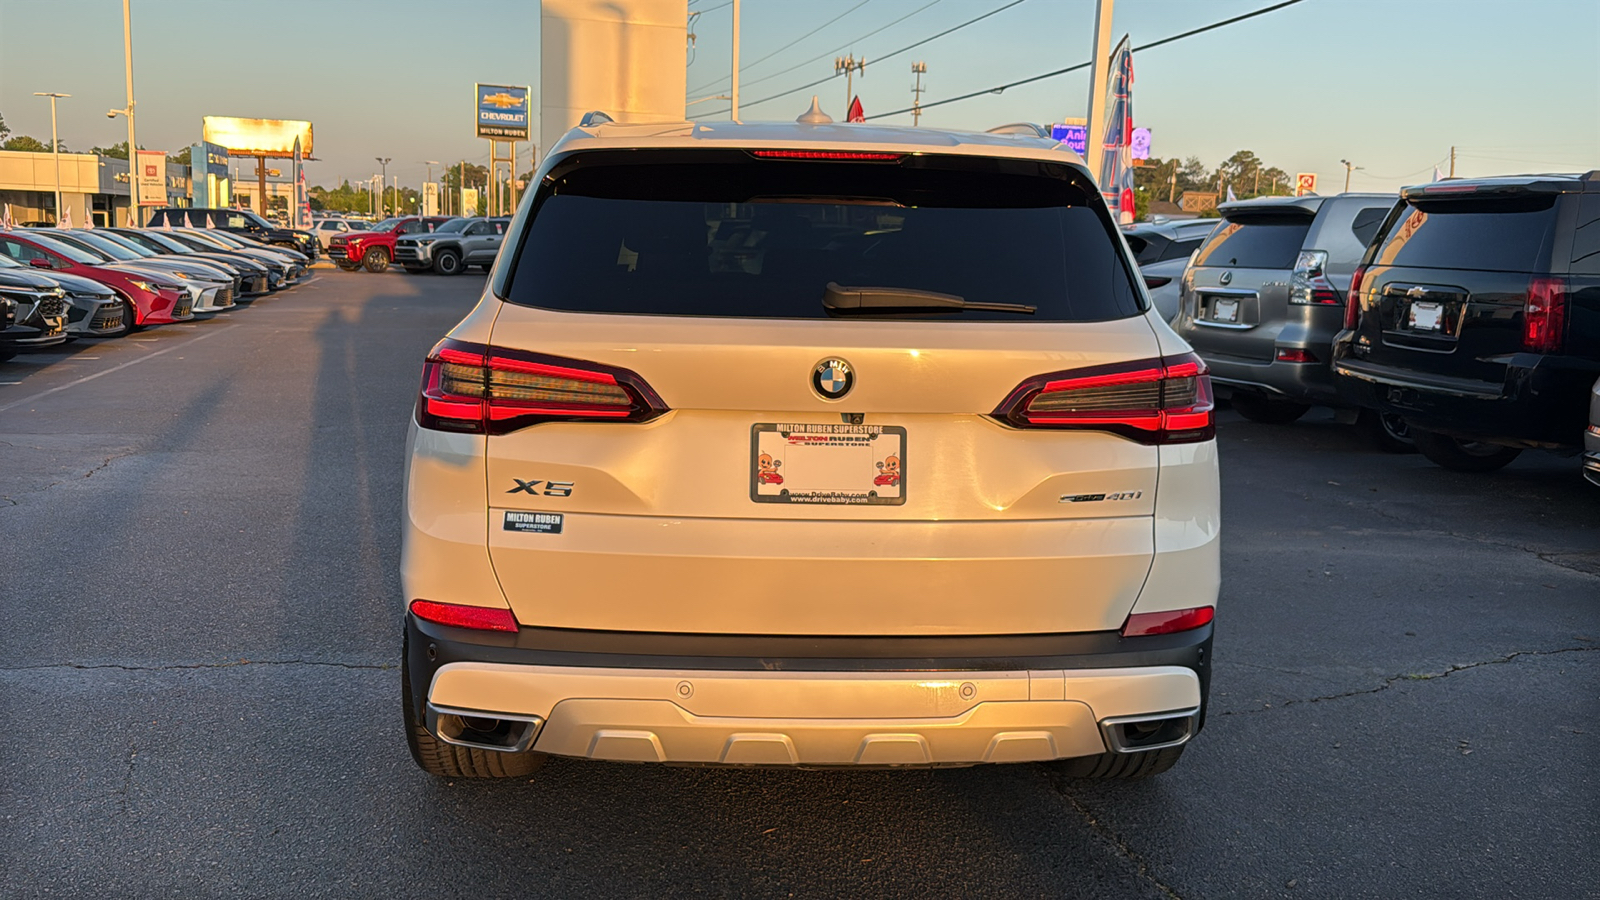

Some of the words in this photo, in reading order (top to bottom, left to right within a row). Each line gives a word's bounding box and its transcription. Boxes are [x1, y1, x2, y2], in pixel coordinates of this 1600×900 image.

[481, 112, 525, 122] CHEVROLET
[480, 127, 503, 135] MILTON
[504, 129, 526, 137] RUBEN
[817, 360, 850, 374] BMW
[776, 423, 804, 433] MILTON
[806, 424, 831, 433] RUBEN
[833, 424, 884, 434] SUPERSTORE
[505, 478, 575, 497] X5
[790, 496, 868, 504] www.drivebaby.com
[506, 512, 534, 523] MILTON
[535, 514, 561, 525] RUBEN
